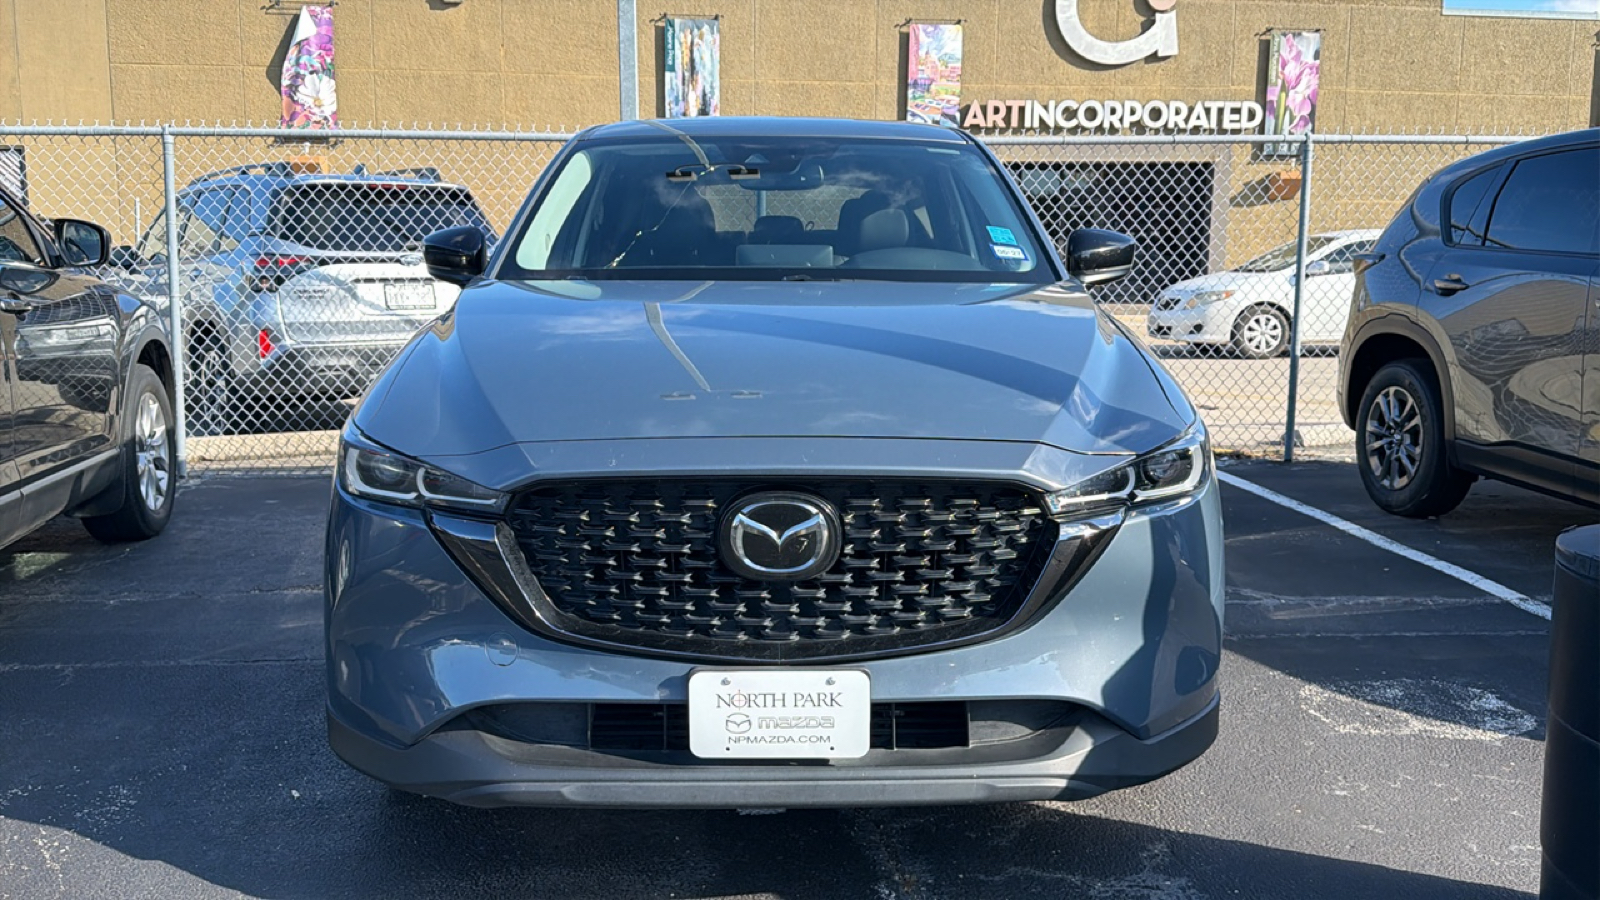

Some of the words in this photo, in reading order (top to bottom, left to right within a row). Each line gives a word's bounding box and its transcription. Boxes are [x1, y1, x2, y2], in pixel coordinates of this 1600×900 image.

[715, 691, 786, 709] NORTH
[793, 692, 843, 708] PARK
[757, 716, 836, 730] mazda
[728, 735, 831, 744] NPMAZDA.COM
